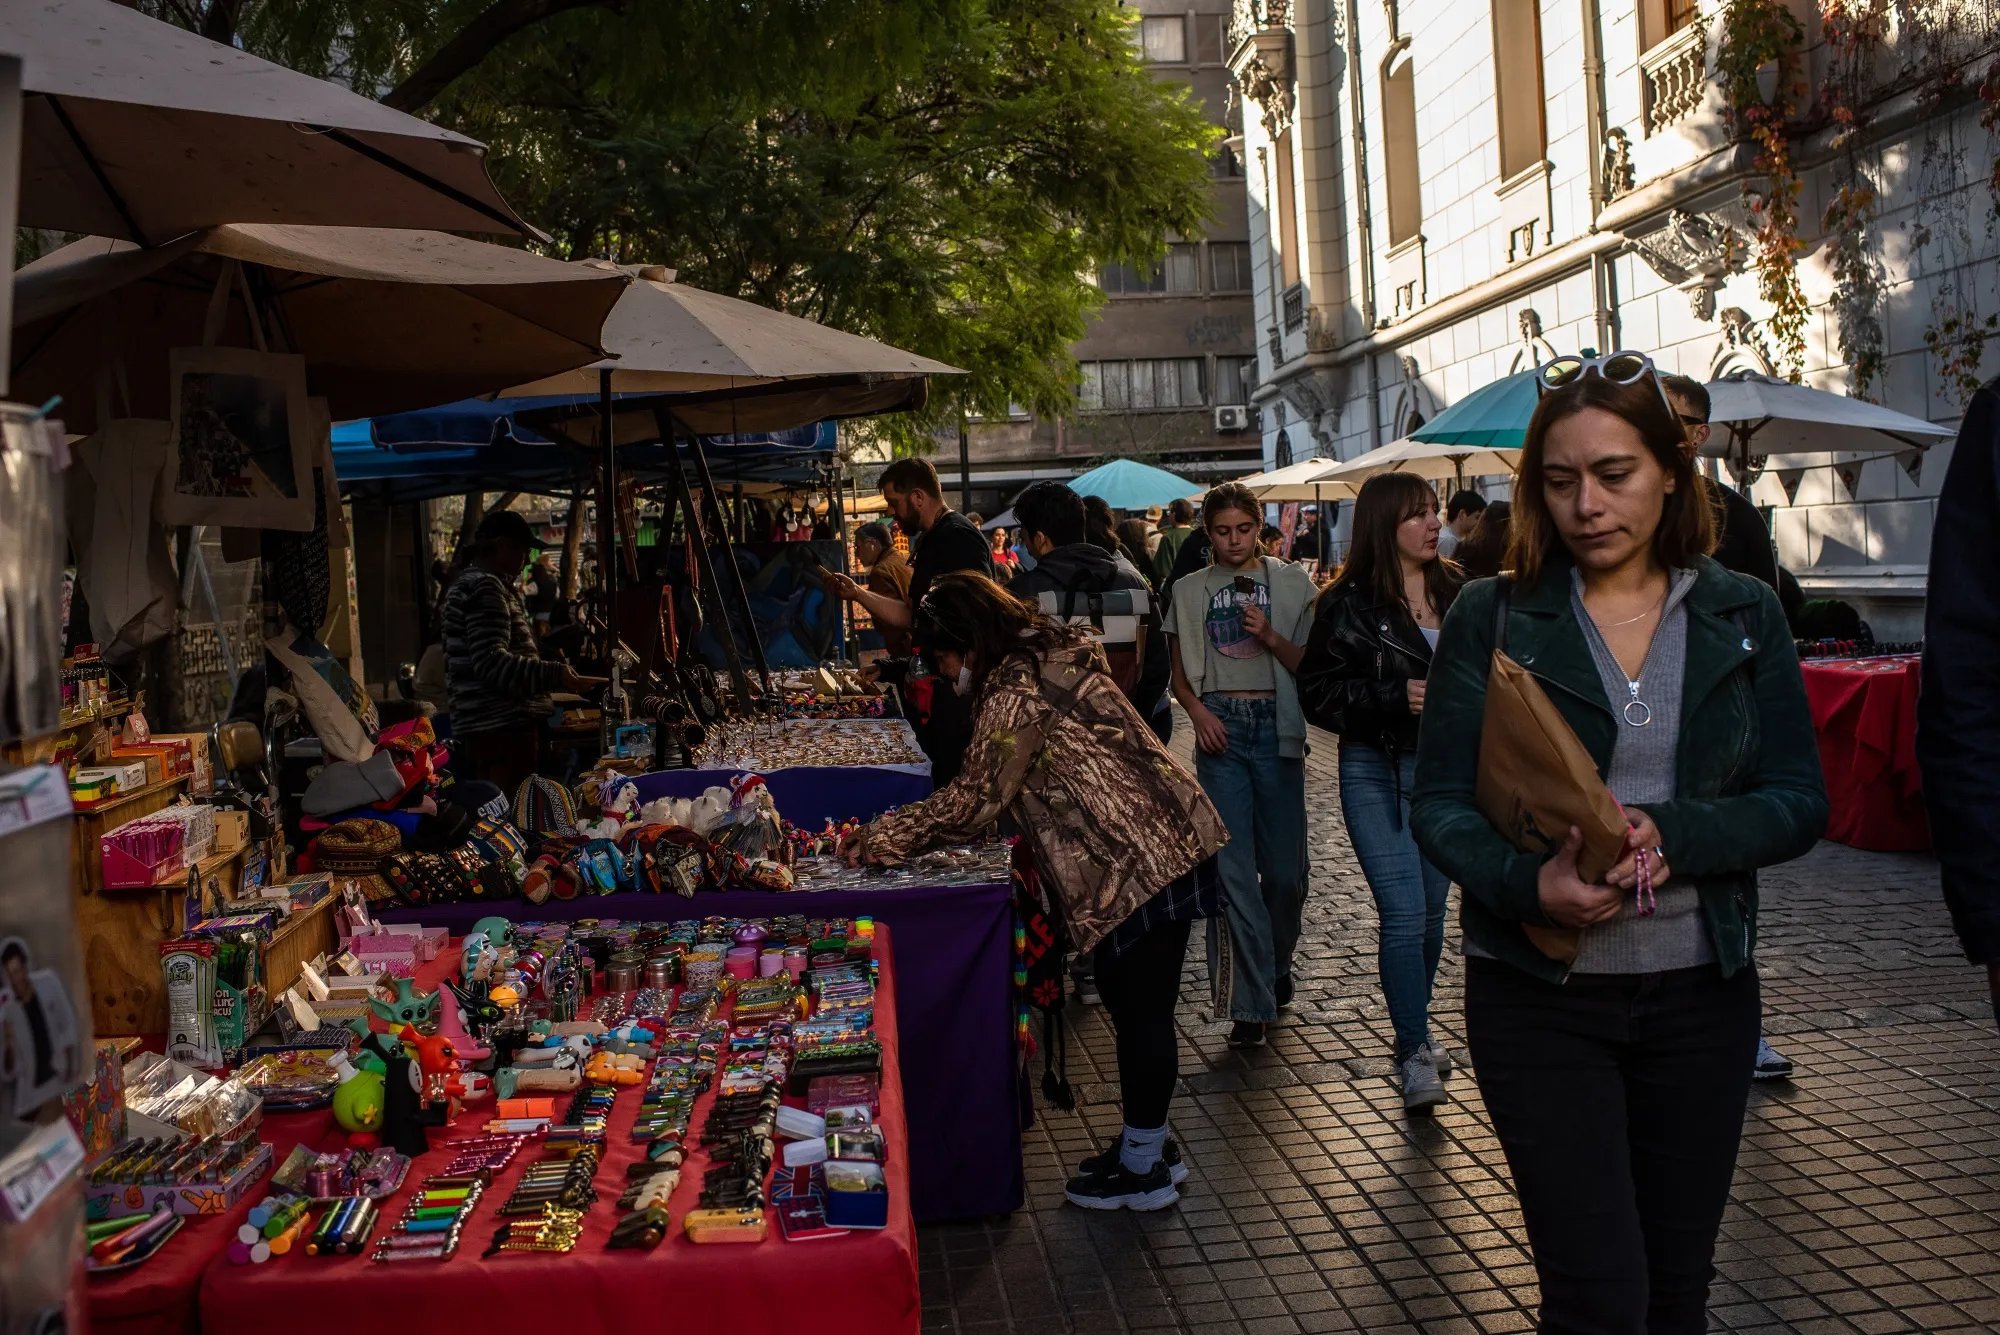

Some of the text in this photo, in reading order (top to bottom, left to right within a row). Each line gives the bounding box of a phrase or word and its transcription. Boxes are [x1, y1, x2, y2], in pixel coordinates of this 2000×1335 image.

[1213, 588, 1231, 609] NO
[168, 971, 194, 981] HEMP
[213, 1007, 232, 1016] RCUS
